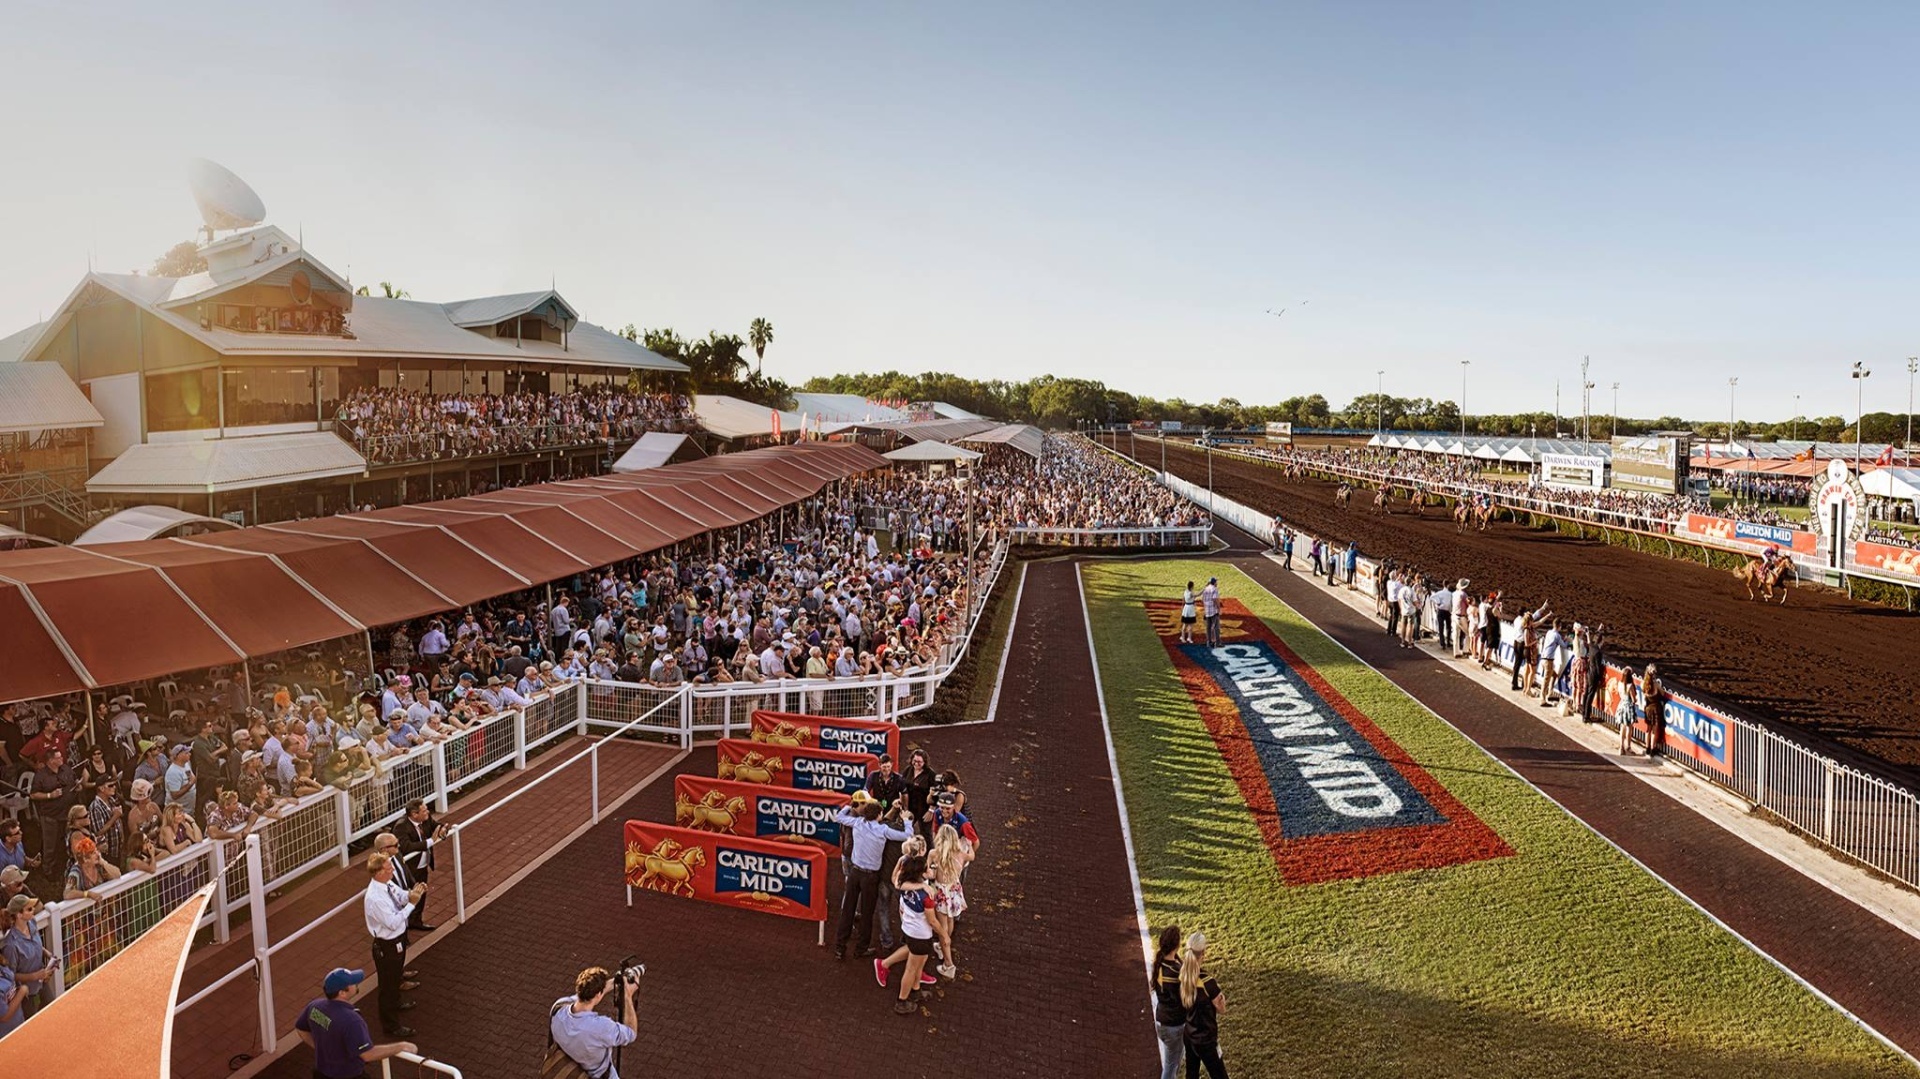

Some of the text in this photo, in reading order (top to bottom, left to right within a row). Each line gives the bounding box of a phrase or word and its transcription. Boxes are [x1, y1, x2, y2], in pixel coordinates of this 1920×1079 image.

[1544, 455, 1601, 467] DARWIN RACING
[1809, 484, 1821, 534] WELCOME
[1817, 473, 1827, 484] TO
[1820, 485, 1842, 505] DARWIN
[1736, 522, 1792, 542] CARLTON MID
[1776, 521, 1801, 530] DARWIN
[1867, 535, 1910, 548] AUSTRALIA
[820, 727, 887, 746] CARLTON
[1211, 644, 1403, 818] CARLTON MID
[1689, 713, 1723, 748] MID
[837, 741, 868, 754] MID
[794, 758, 866, 779] CARLTON
[812, 774, 846, 790] MID
[757, 799, 839, 823] CARLTON
[778, 817, 817, 836] MID
[717, 850, 809, 880] CARLTON
[740, 871, 783, 893] MID
